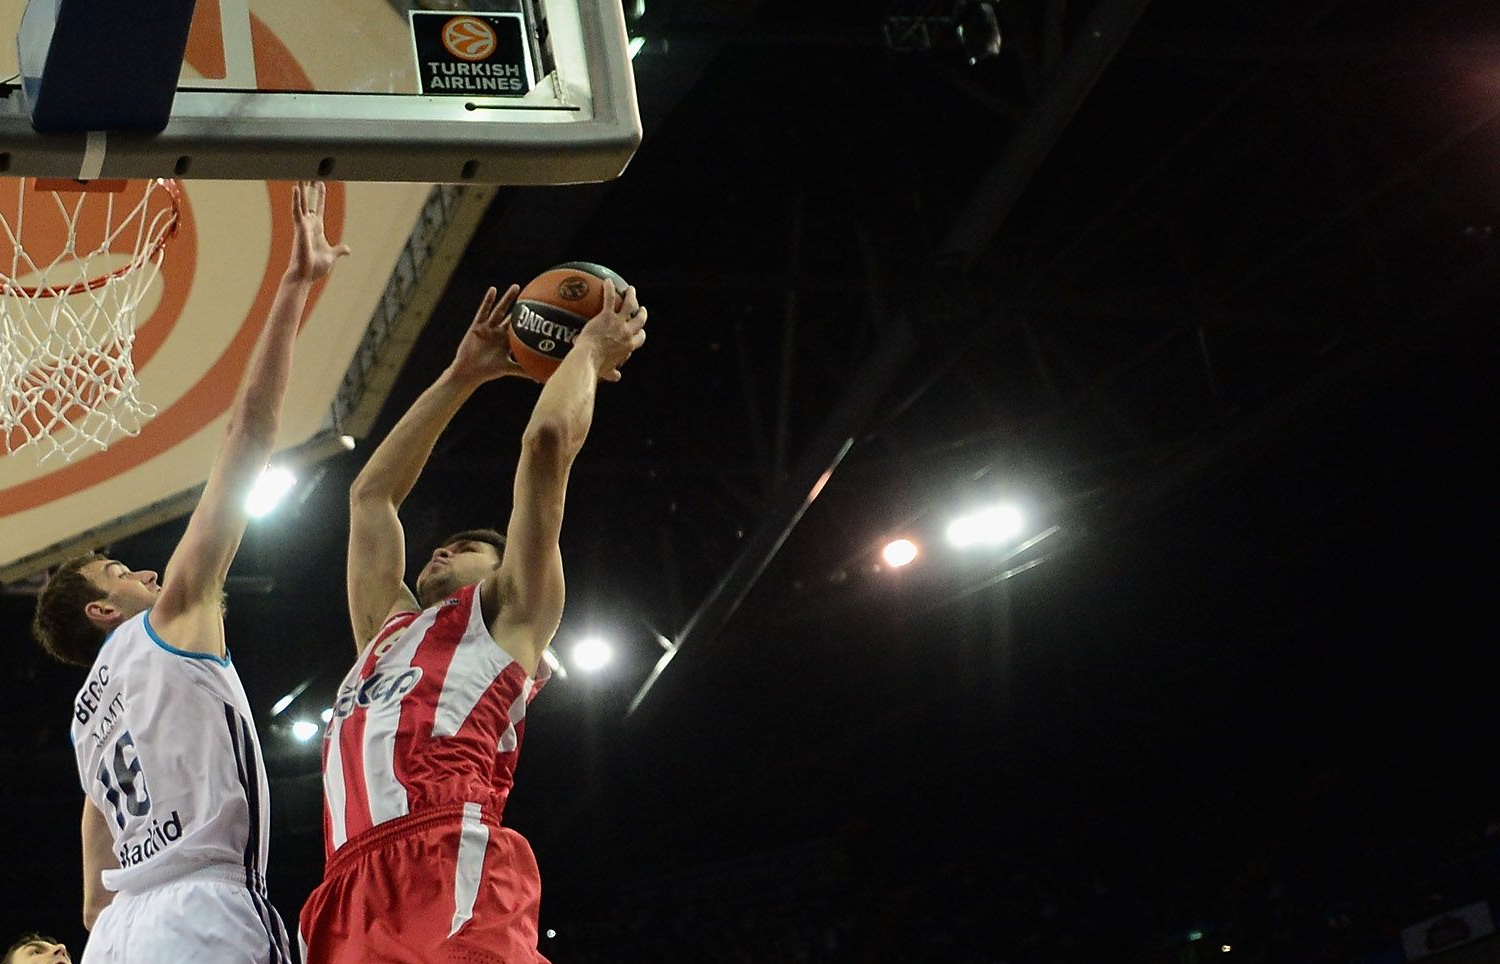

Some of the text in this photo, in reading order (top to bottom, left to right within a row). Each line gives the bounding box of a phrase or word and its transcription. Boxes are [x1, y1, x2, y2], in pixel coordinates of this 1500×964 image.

[428, 62, 519, 77] TURKISH
[431, 76, 522, 91] AIRLINES
[516, 303, 578, 344] ALDING
